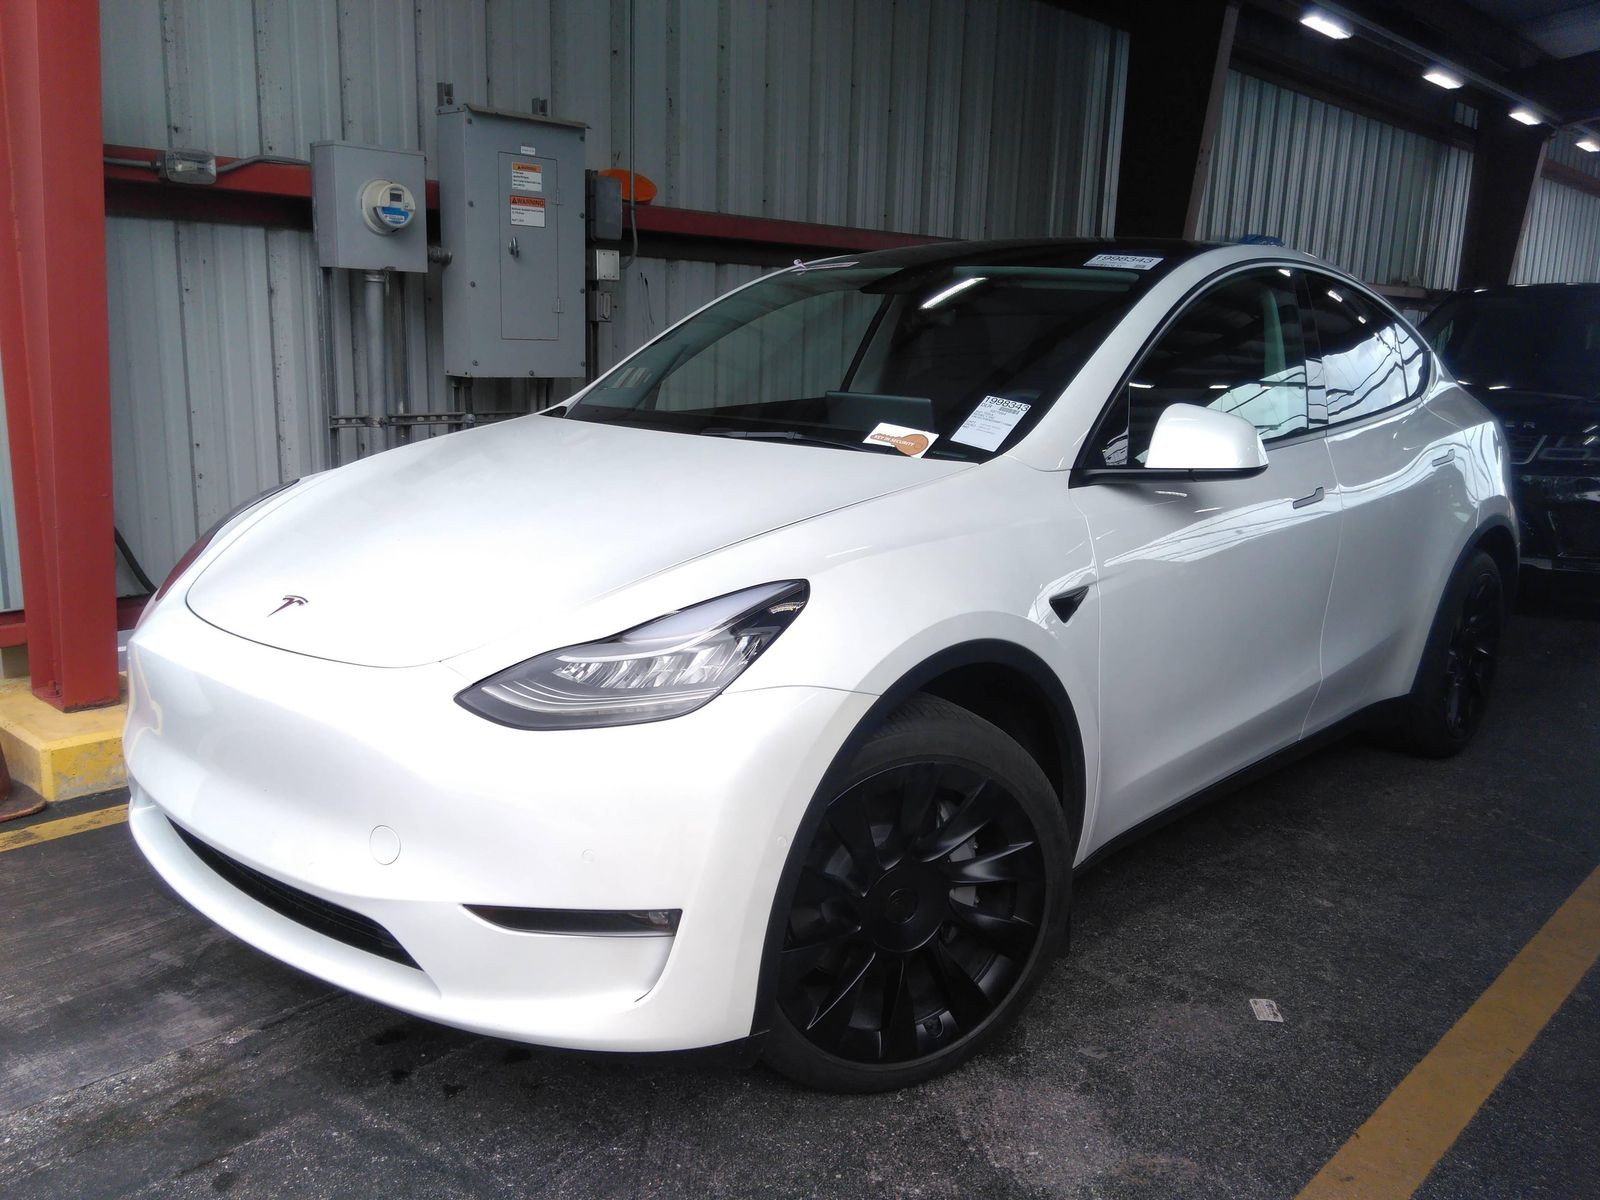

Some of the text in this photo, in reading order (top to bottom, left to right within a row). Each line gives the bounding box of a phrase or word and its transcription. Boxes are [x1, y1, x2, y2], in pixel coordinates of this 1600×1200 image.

[516, 197, 544, 207] WARNING
[1096, 255, 1154, 263] 1998343
[985, 396, 1030, 412] 1998343
[892, 437, 915, 447] SECURITY
